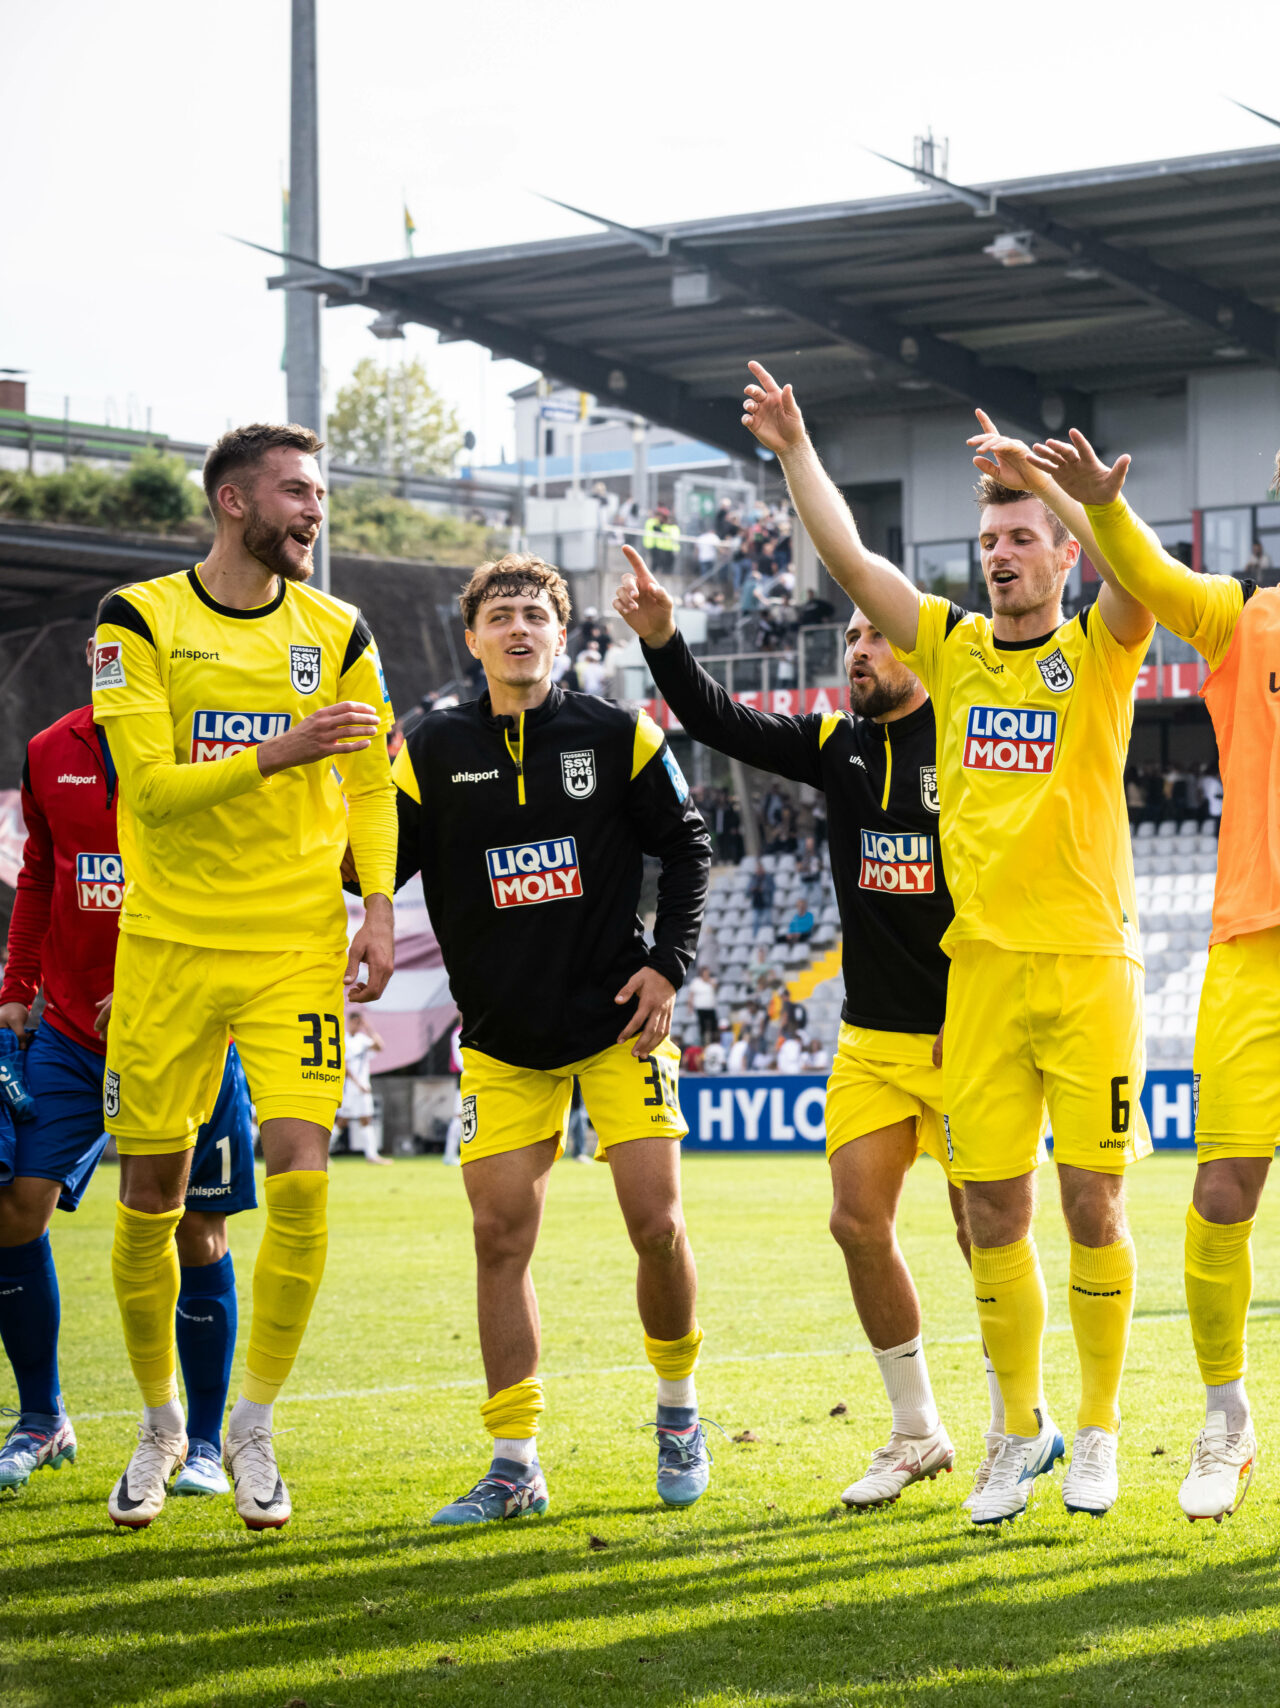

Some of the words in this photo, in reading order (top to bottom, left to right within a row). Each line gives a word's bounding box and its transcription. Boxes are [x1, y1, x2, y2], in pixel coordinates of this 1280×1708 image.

[292, 652, 319, 664] SSV
[292, 662, 319, 673] 1846
[1040, 654, 1063, 673] SSV
[1043, 663, 1068, 679] 1846
[971, 709, 1052, 740] LIQUI
[564, 757, 592, 768] SSV
[968, 739, 1053, 770] MOLY
[57, 773, 97, 786] uhlsport
[451, 769, 499, 784] uhlsport
[565, 766, 593, 778] 1846
[922, 773, 937, 783] SS
[491, 840, 575, 877] LIQUI
[863, 832, 928, 863] LIQUI
[81, 856, 124, 882] LIQ
[864, 861, 931, 890] MOLY
[81, 884, 125, 908] MO
[496, 869, 577, 905] MOLY
[298, 1013, 342, 1070] 33
[301, 1070, 342, 1084] uhlsport
[698, 1086, 831, 1142] HYLO
[1110, 1076, 1130, 1133] 6
[216, 1136, 232, 1185] 1
[1072, 1284, 1121, 1297] uhlsport
